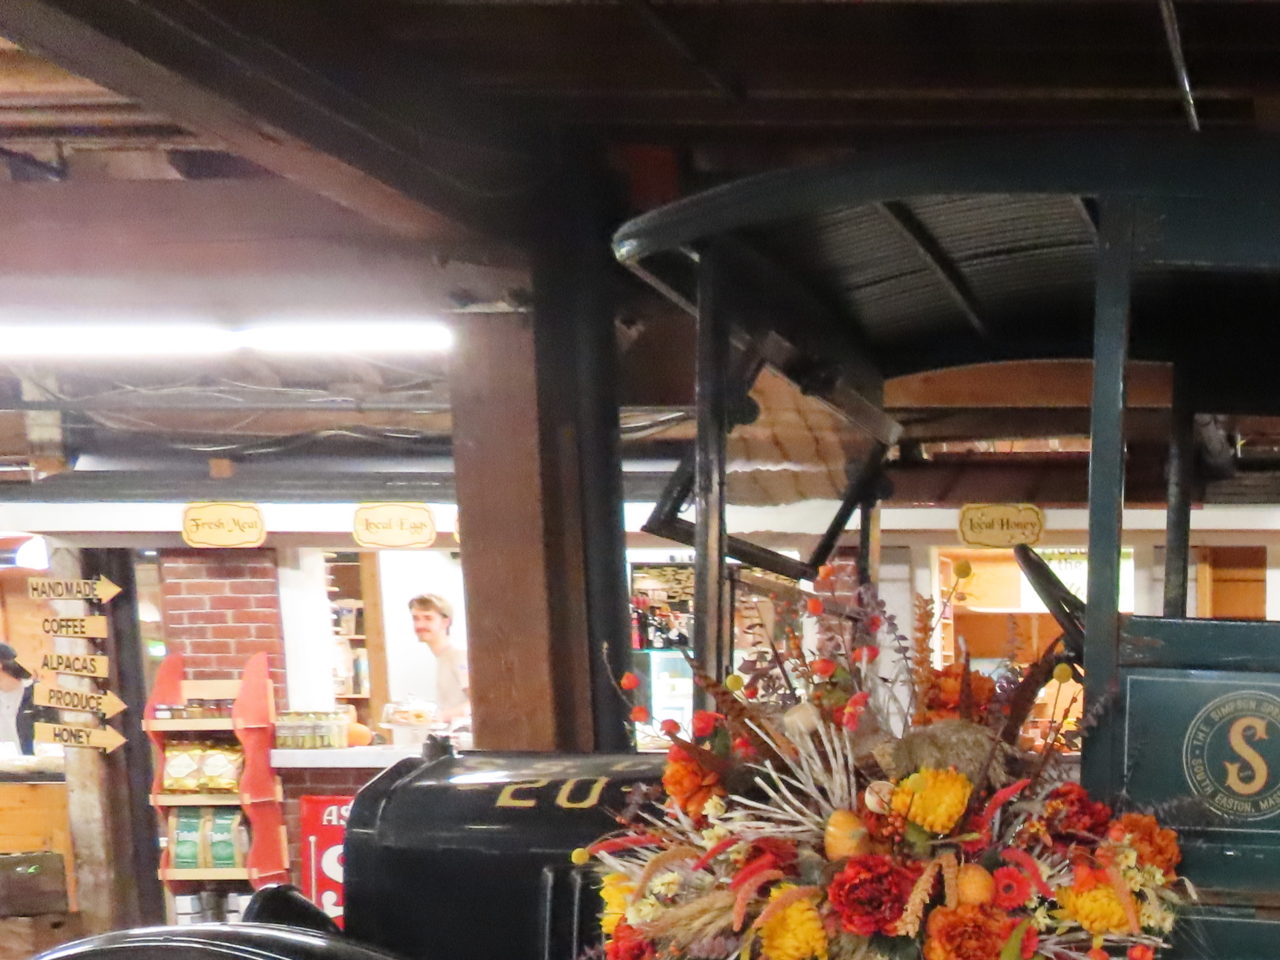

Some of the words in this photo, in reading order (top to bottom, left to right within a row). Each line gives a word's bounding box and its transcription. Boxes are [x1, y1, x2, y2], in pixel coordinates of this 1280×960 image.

[969, 518, 995, 531] Local
[1000, 518, 1037, 531] Honey
[30, 581, 99, 598] HANDMADE
[42, 618, 86, 635] COFFEE
[41, 654, 97, 674] ALPACAS
[49, 689, 102, 711] PRODUCE
[1193, 723, 1210, 745] THE
[1210, 700, 1257, 722] SIMPSON
[53, 727, 92, 746] HONEY
[1223, 716, 1269, 795] S
[1192, 758, 1215, 794] SOUTH
[322, 804, 350, 826] AS
